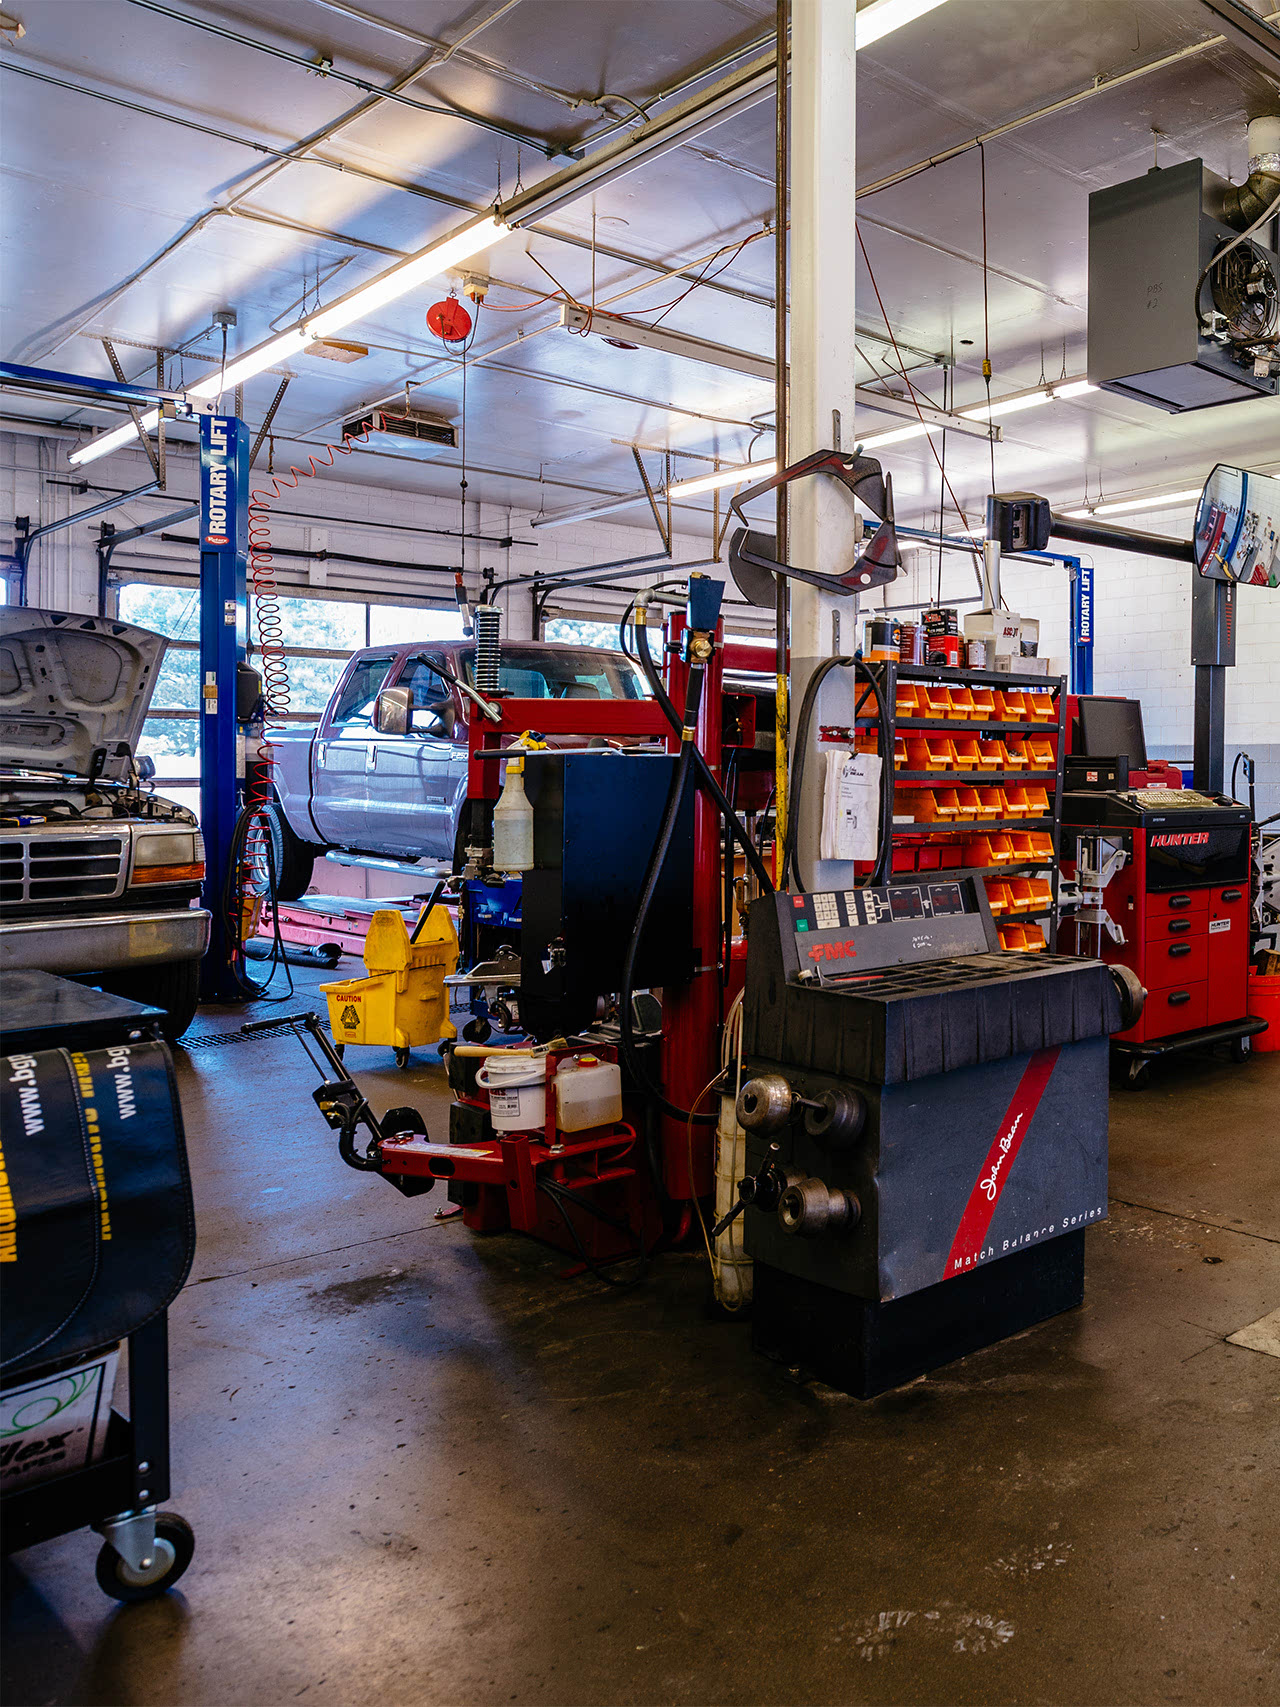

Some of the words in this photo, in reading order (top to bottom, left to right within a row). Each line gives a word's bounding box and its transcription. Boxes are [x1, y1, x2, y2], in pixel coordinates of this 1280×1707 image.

[210, 416, 228, 457] LIFT
[208, 461, 228, 535] ROTARY
[1081, 569, 1091, 592] LIFT
[1081, 594, 1090, 637] ROTARY
[1150, 832, 1209, 848] HUNTER
[808, 940, 857, 962] FMC
[336, 995, 362, 1003] CAUTION
[980, 1154, 1006, 1201] John
[999, 1113, 1024, 1154] Bean
[954, 1246, 994, 1270] Match
[1062, 1207, 1103, 1228] Series
